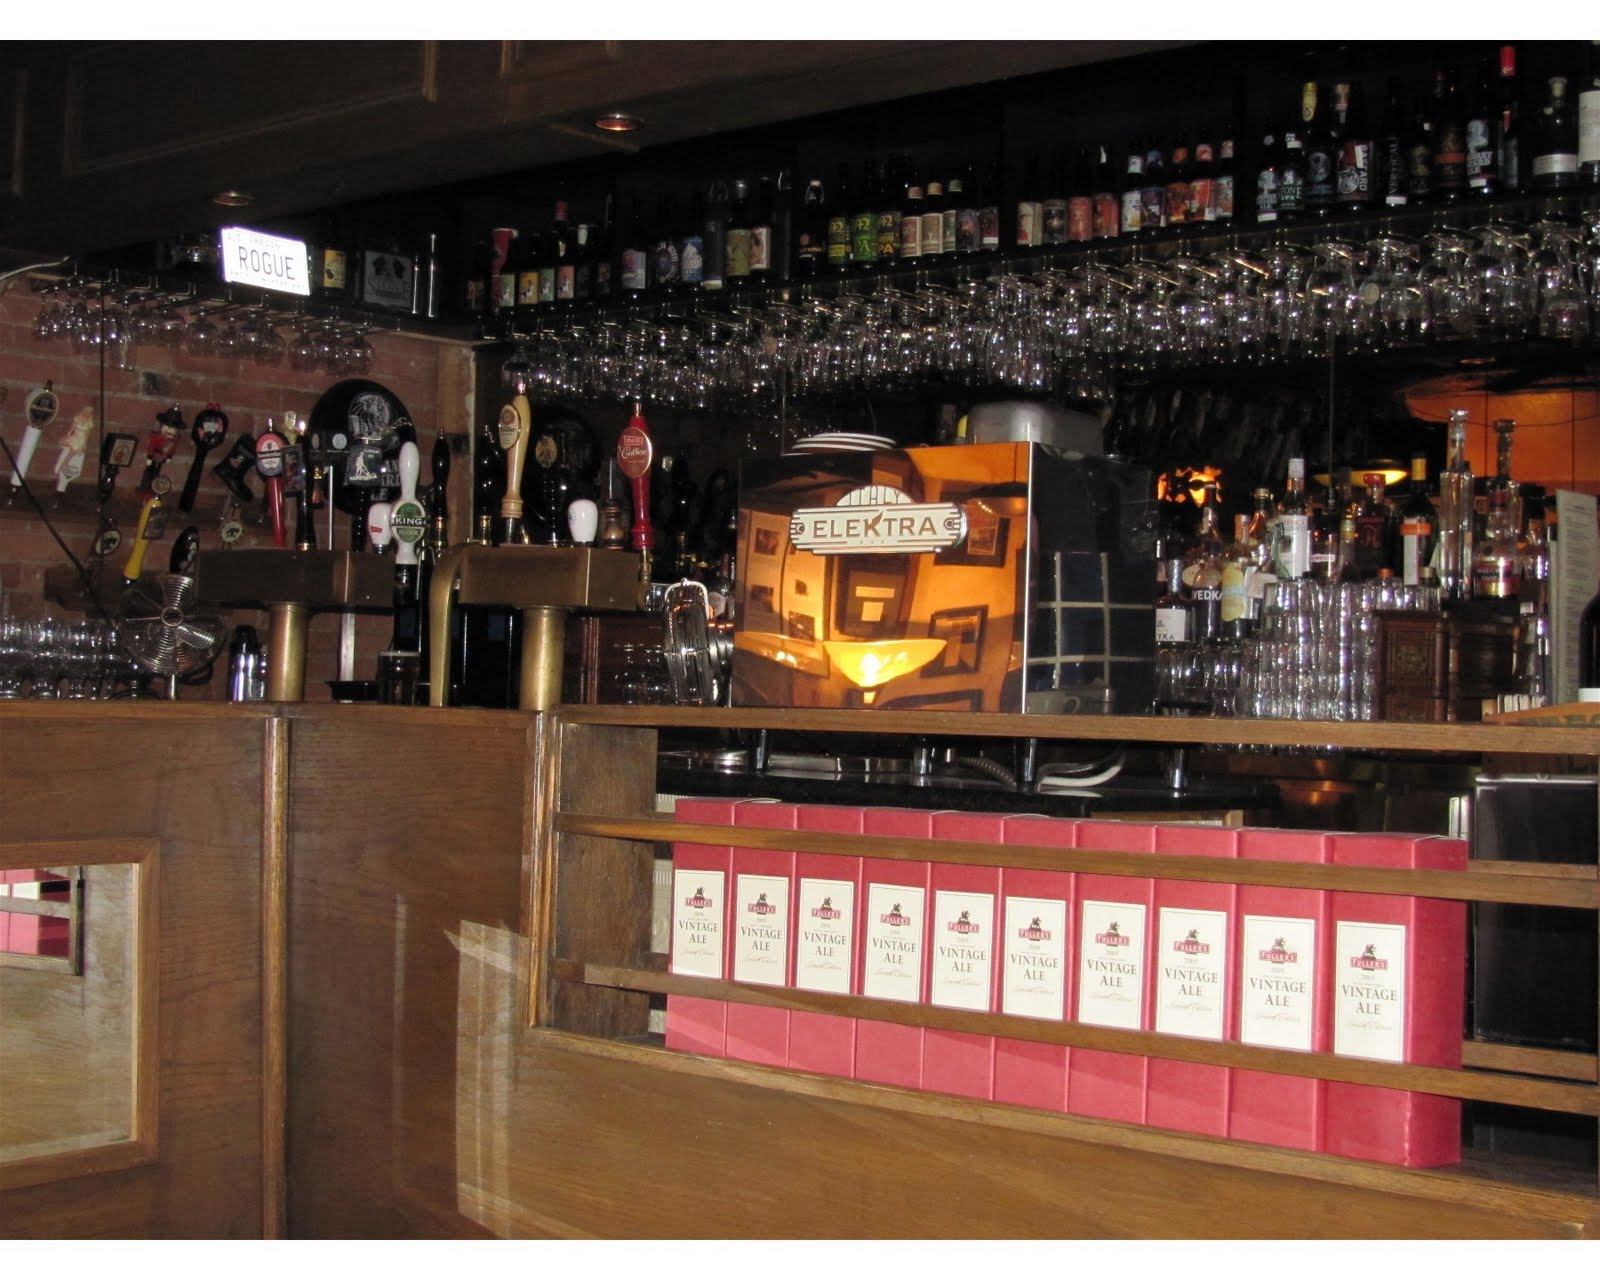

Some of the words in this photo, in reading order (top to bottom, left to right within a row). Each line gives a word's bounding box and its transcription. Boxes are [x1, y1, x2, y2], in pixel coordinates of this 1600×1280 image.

[238, 245, 296, 281] ROGUE
[621, 446, 647, 459] Coffee
[395, 517, 422, 525] KING
[813, 510, 937, 538] ELEKTRA
[679, 921, 718, 932] VINTAGE
[689, 933, 707, 944] ALE
[741, 927, 782, 939] VINTAGE
[804, 932, 847, 945] VINTAGE
[752, 940, 770, 951] ALE
[872, 937, 916, 952] VINTAGE
[815, 946, 834, 957] ALE
[939, 946, 986, 961] VINTAGE
[884, 953, 903, 964] ALE
[1010, 954, 1058, 968] VINTAGE
[952, 961, 972, 973] ALE
[1087, 959, 1136, 974] VINTAGE
[1024, 969, 1045, 981] ALE
[1100, 975, 1122, 987] ALE
[1165, 968, 1218, 983] VINTAGE
[1178, 984, 1202, 996] ALE
[1250, 978, 1306, 993] VINTAGE
[1342, 985, 1397, 1000] VINTAGE
[1265, 994, 1289, 1007] ALE
[1356, 1002, 1380, 1014] ALE
